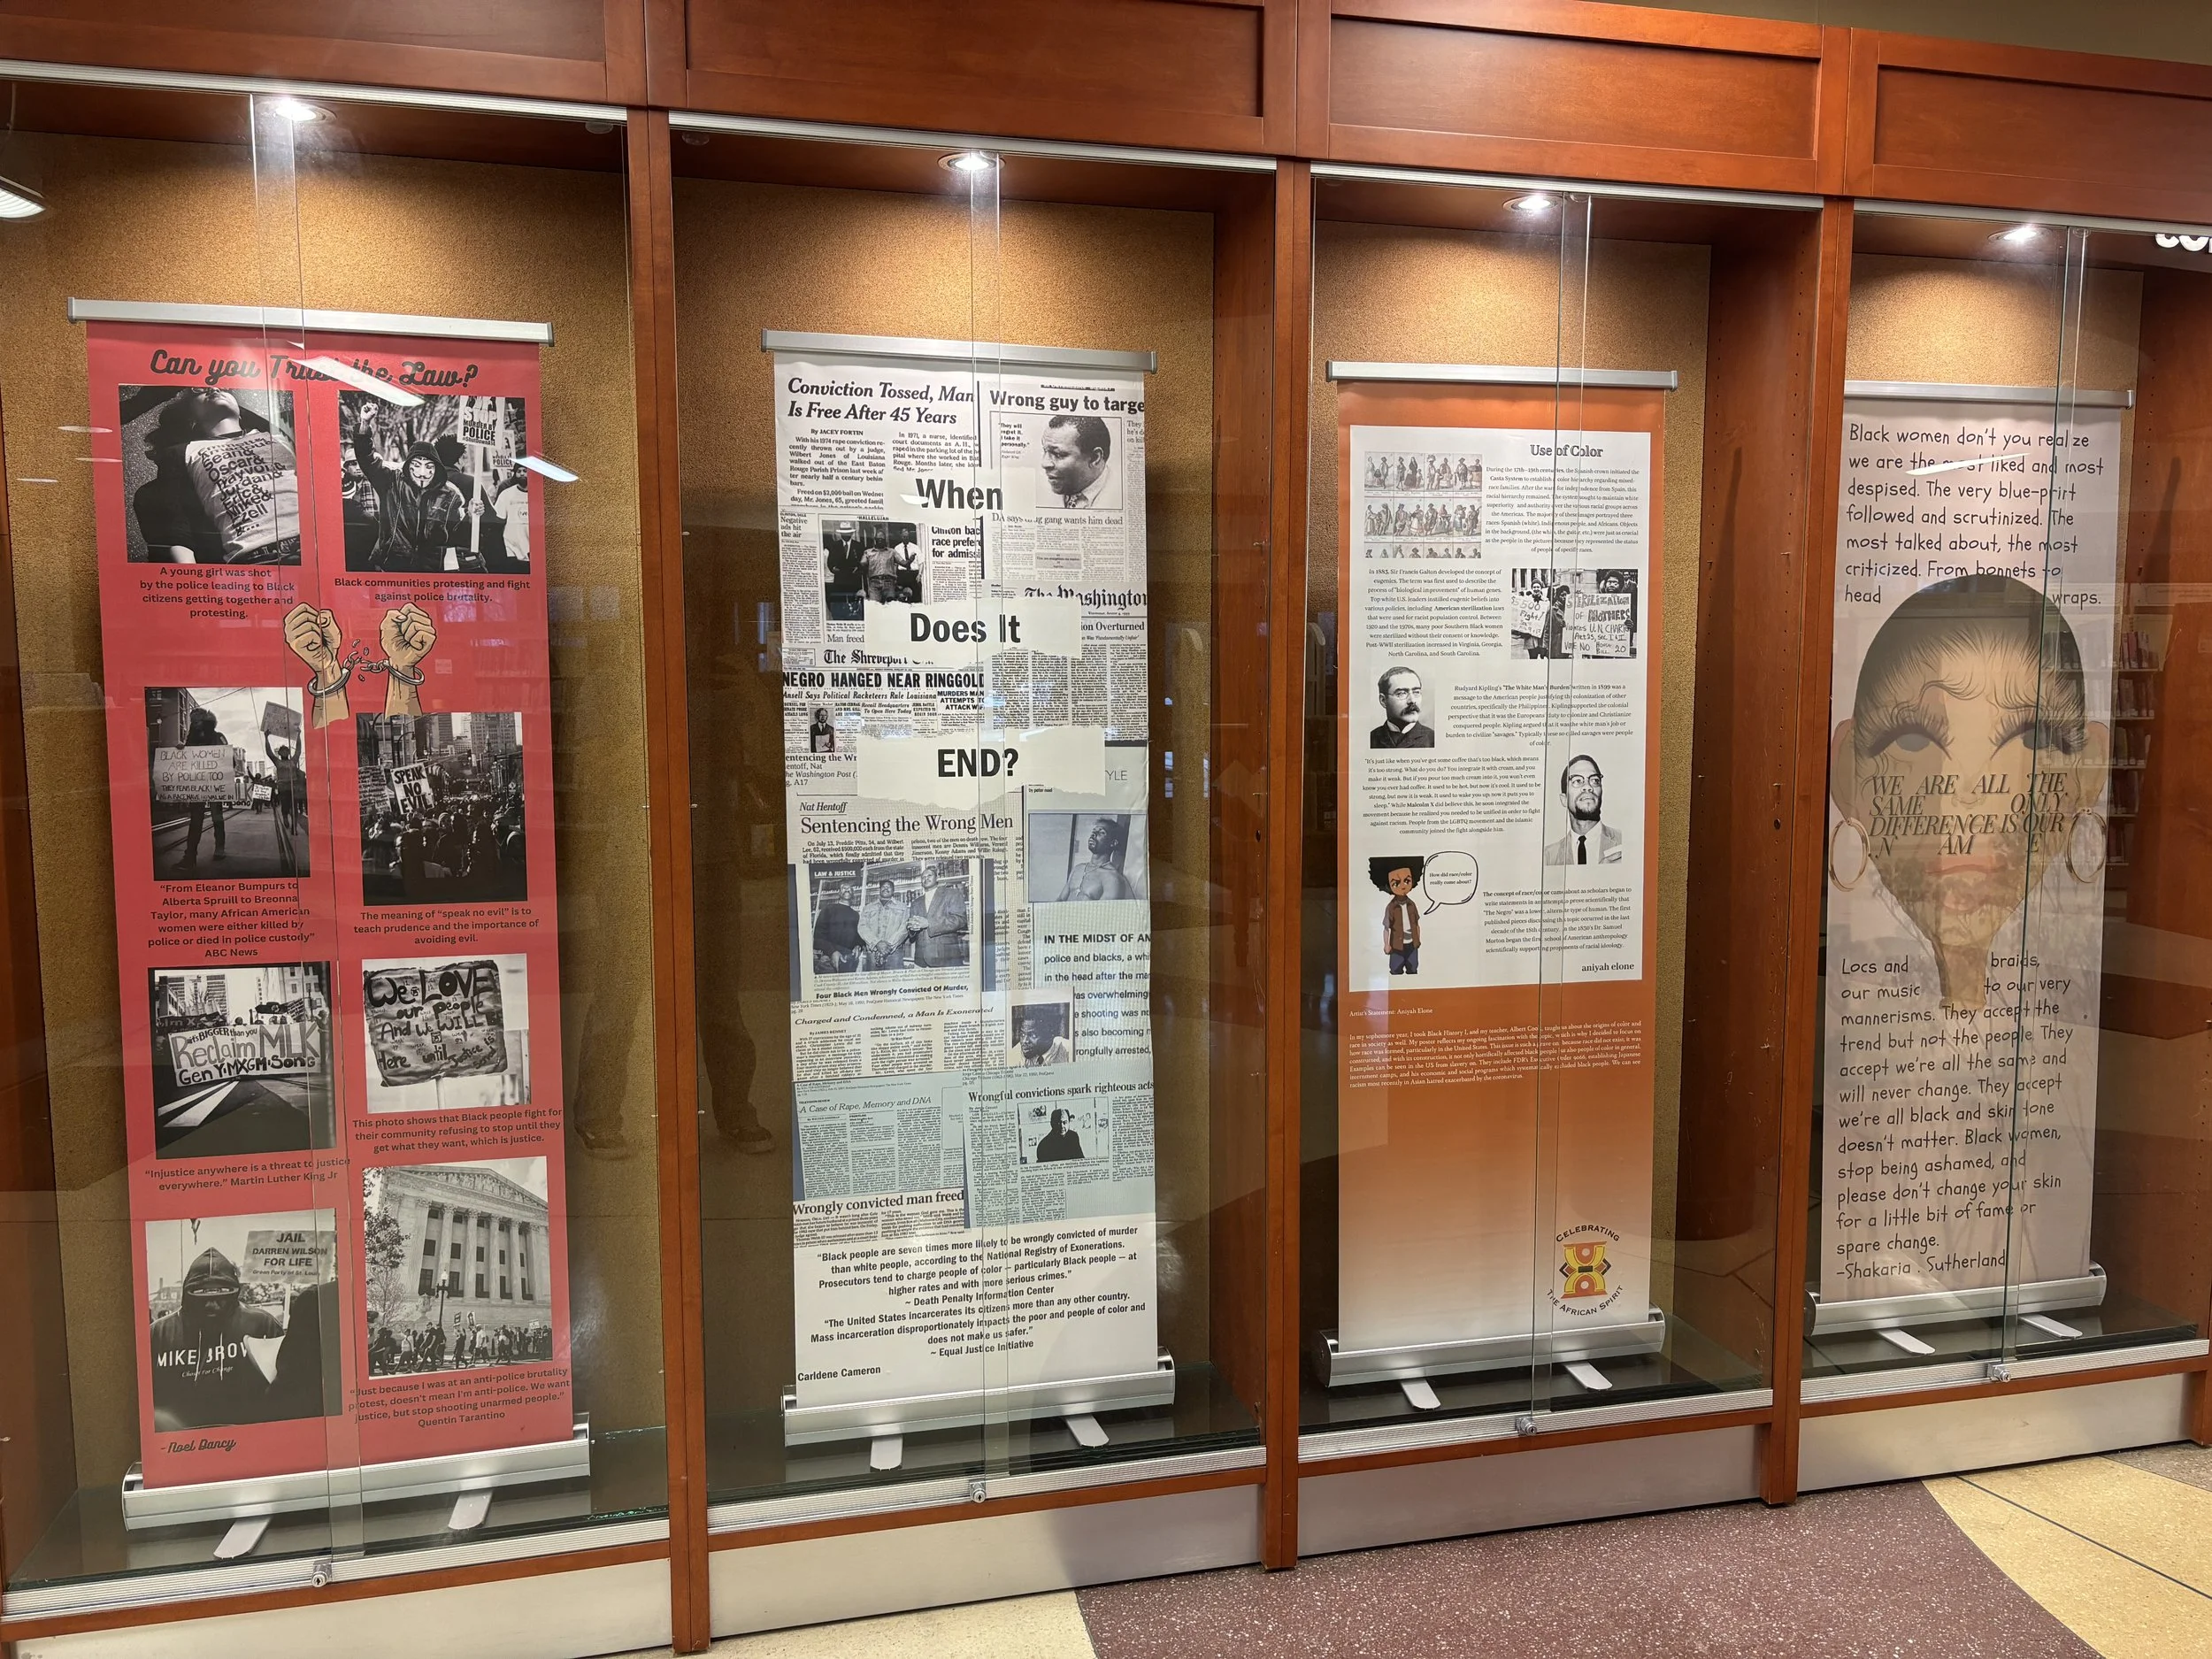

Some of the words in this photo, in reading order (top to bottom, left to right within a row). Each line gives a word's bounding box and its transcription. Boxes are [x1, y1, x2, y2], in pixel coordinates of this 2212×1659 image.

[150, 349, 202, 375] Can
[205, 360, 261, 386] you
[399, 361, 479, 388] Law?
[788, 377, 873, 397] Conviction
[879, 381, 933, 403] Tossed,
[938, 386, 973, 402] Man
[989, 390, 1045, 411] Wrong
[1049, 396, 1079, 411] guy
[1083, 396, 1100, 410] to
[787, 400, 803, 418] Is
[806, 401, 841, 419] Free
[844, 403, 887, 420] After
[889, 407, 910, 421] 45
[915, 407, 956, 424] Years
[464, 420, 488, 429] MURDER
[463, 426, 495, 442] POLICE
[1849, 423, 1890, 442] Black
[1897, 431, 1949, 445] women
[1956, 426, 1997, 447] don't
[2003, 434, 2032, 450] you
[1530, 444, 1553, 457] Use
[1556, 445, 1570, 456] of
[1570, 445, 1603, 457] Color
[1849, 456, 1869, 469] we
[1876, 457, 1903, 469] are
[1910, 452, 1935, 470] the
[1991, 455, 2025, 473] liked
[2032, 456, 2057, 475] and
[2065, 457, 2104, 475] most
[916, 479, 1002, 510] When
[1847, 478, 1920, 502] despised.
[1926, 480, 1951, 496] The
[1958, 485, 1992, 503] very
[1846, 504, 1915, 524] followed
[1921, 506, 1947, 525] and
[1954, 508, 2043, 526] scrutinized.
[2050, 509, 2074, 526] The
[205, 567, 223, 578] girl
[248, 568, 272, 577] shot
[140, 580, 152, 590] by
[156, 580, 173, 589] the
[176, 580, 209, 591] police
[211, 581, 250, 592] leading
[252, 582, 264, 591] to
[266, 582, 295, 591] Black
[334, 578, 362, 587] Black
[365, 579, 431, 588] communities
[433, 580, 485, 590] protesting
[487, 580, 505, 588] and
[507, 580, 531, 591] fight
[142, 594, 183, 603] citizens
[186, 595, 224, 605] getting
[226, 595, 272, 605] together
[375, 593, 411, 602] against
[414, 593, 444, 602] police
[447, 593, 493, 603] brutality.
[1845, 585, 1881, 604] head
[2052, 591, 2101, 610] wraps.
[189, 608, 249, 619] protesting.
[910, 612, 987, 643] Does
[999, 614, 1021, 643] It
[1095, 621, 1145, 631] Overturned
[783, 672, 825, 687] NEGRO
[831, 672, 882, 687] HANGED
[887, 672, 920, 687] NEAR
[161, 750, 187, 761] BLACK
[192, 749, 226, 759] WOMEN
[938, 749, 1018, 778] END?
[168, 761, 188, 771] ARE
[190, 760, 219, 770] KILLED
[394, 765, 426, 784] SPEAK
[163, 772, 173, 782] BY
[208, 772, 224, 781] TOO
[1871, 776, 1904, 795] WE
[1916, 774, 1959, 795] ARE
[1971, 773, 2010, 795] ALL
[2027, 772, 2067, 793] THE
[403, 782, 421, 797] NO
[400, 795, 433, 814] EVIL
[800, 803, 815, 811] Nat
[816, 802, 849, 813] Hentoff
[1869, 795, 1925, 817] SAME
[801, 817, 891, 835] Sentencing
[895, 816, 920, 832] the
[925, 815, 977, 833] Wrong
[980, 813, 1013, 829] Men
[1869, 814, 1997, 837] DIFFERENCE
[2000, 813, 2017, 833] IS
[2023, 812, 2064, 833] OUR
[1044, 935, 1055, 944] IN
[1058, 934, 1079, 943] THE
[1083, 933, 1117, 943] MIDST
[1120, 933, 1133, 942] OF
[1581, 962, 1609, 972] aniyah
[1610, 962, 1634, 971] elone
[1841, 959, 1878, 975] Locs
[1884, 956, 1909, 973] and
[870, 988, 897, 997] Wrongly
[171, 1035, 256, 1069] Reclaim
[259, 1022, 319, 1058] MLK
[968, 1091, 1013, 1103] Wrongful
[1016, 1087, 1064, 1099] convictions
[1067, 1083, 1092, 1095] spark
[1094, 1081, 1136, 1093] righteous
[793, 1201, 843, 1216] Wrongly
[846, 1195, 903, 1210] convicted
[906, 1195, 933, 1205] man
[935, 1190, 964, 1202] freed
[276, 1233, 306, 1242] JAIL
[1555, 1225, 1620, 1242] CELEBRATING
[1837, 1240, 1880, 1260] spare
[1886, 1233, 1939, 1255] change.
[1927, 1249, 2006, 1272] Sutherland
[1559, 1304, 1598, 1316] AFRICAN
[1599, 1285, 1624, 1310] SPIRIT
[157, 1349, 196, 1367] MIKE
[797, 1370, 838, 1381] Carldene
[841, 1366, 881, 1378] Cameron
[419, 1417, 457, 1427] Quentin
[459, 1412, 505, 1423] Tarantino
[167, 1440, 196, 1453] Noel
